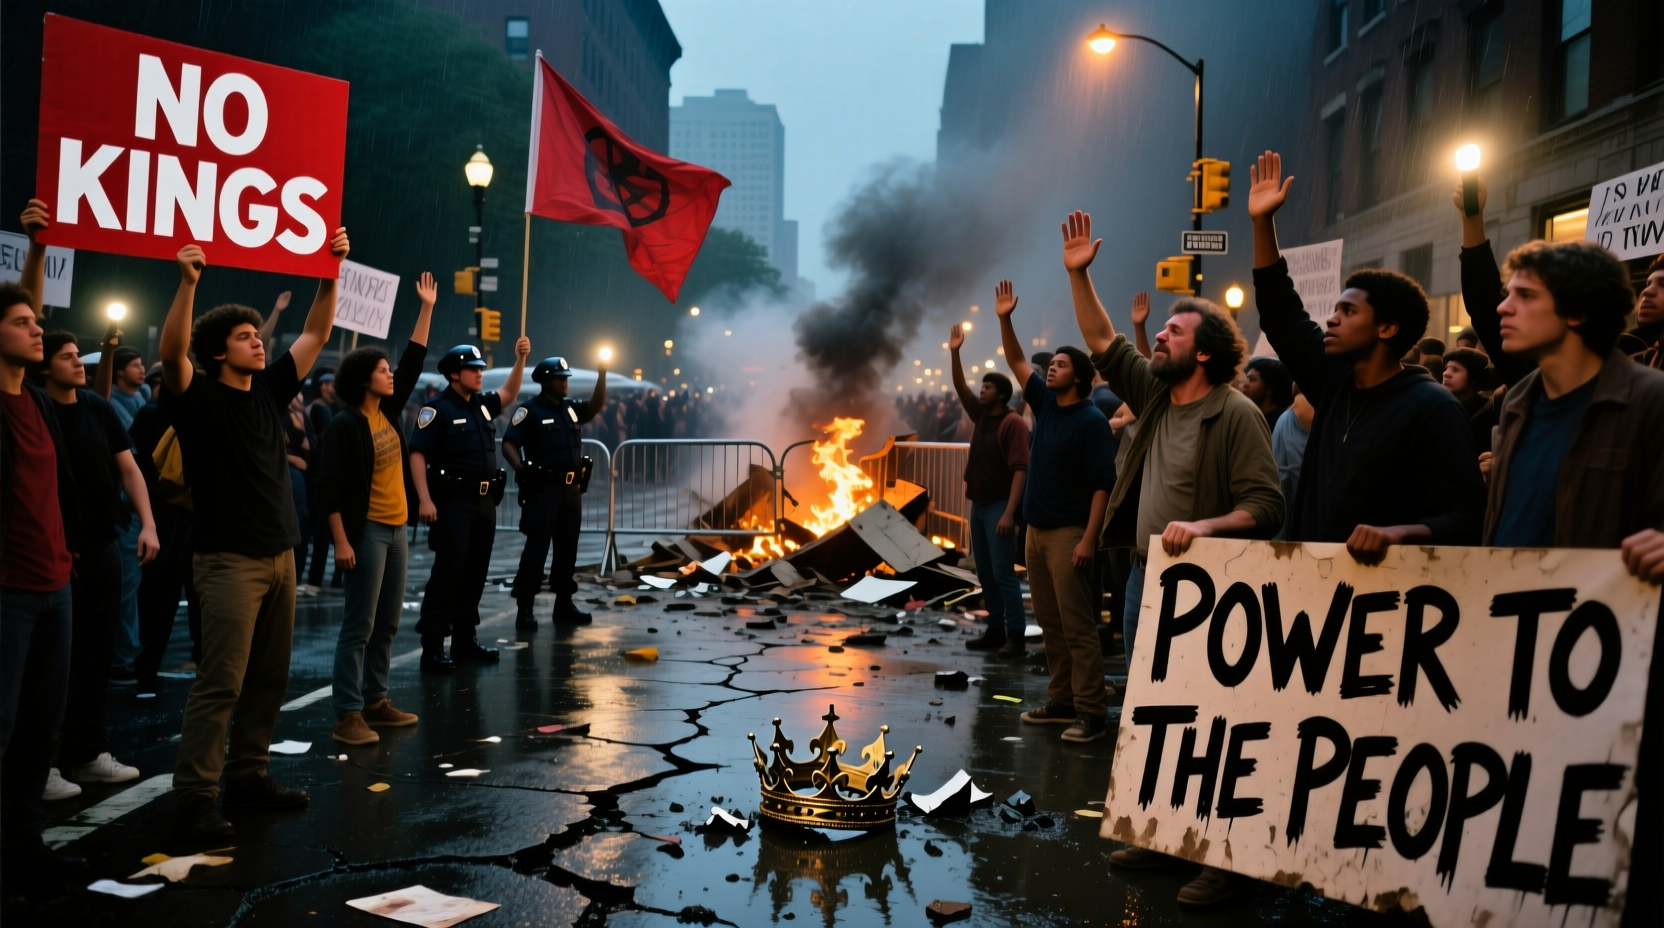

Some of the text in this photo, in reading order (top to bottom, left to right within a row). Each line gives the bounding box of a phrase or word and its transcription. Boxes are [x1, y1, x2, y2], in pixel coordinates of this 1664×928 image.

[135, 54, 269, 156] NO
[57, 138, 328, 255] KINGS
[1150, 562, 1623, 722] POWER TO
[1131, 705, 1632, 907] THE PEOPLE
